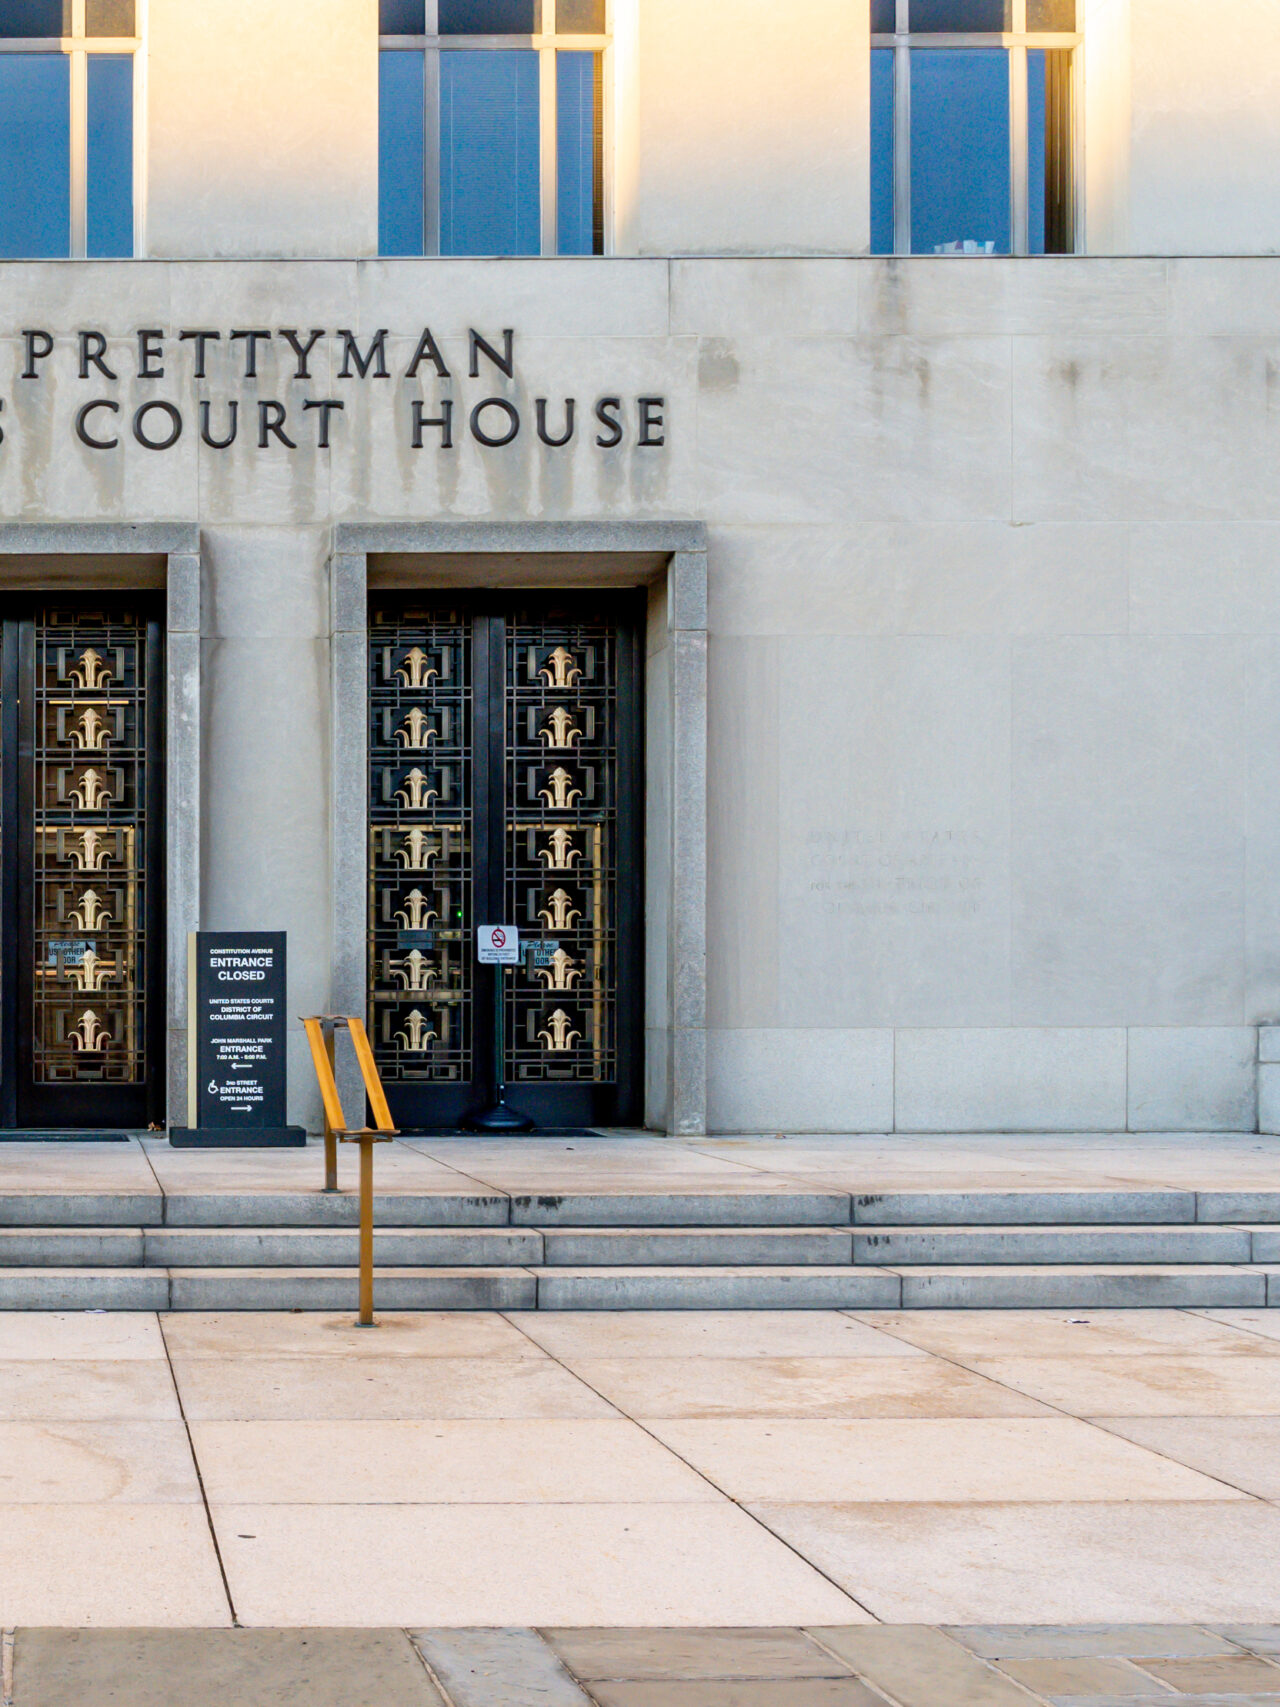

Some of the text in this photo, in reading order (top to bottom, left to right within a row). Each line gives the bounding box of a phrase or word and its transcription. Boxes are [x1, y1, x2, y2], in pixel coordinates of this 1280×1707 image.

[21, 328, 514, 380] PRETTYMAN
[76, 398, 345, 451] COURT
[411, 397, 665, 449] HOUSE
[209, 957, 273, 968] ENTRANCE
[534, 957, 550, 965] OOR
[217, 970, 266, 981] CLOSED
[219, 1045, 264, 1053] ENTRANCE
[219, 1086, 264, 1094] ENTRANCE
